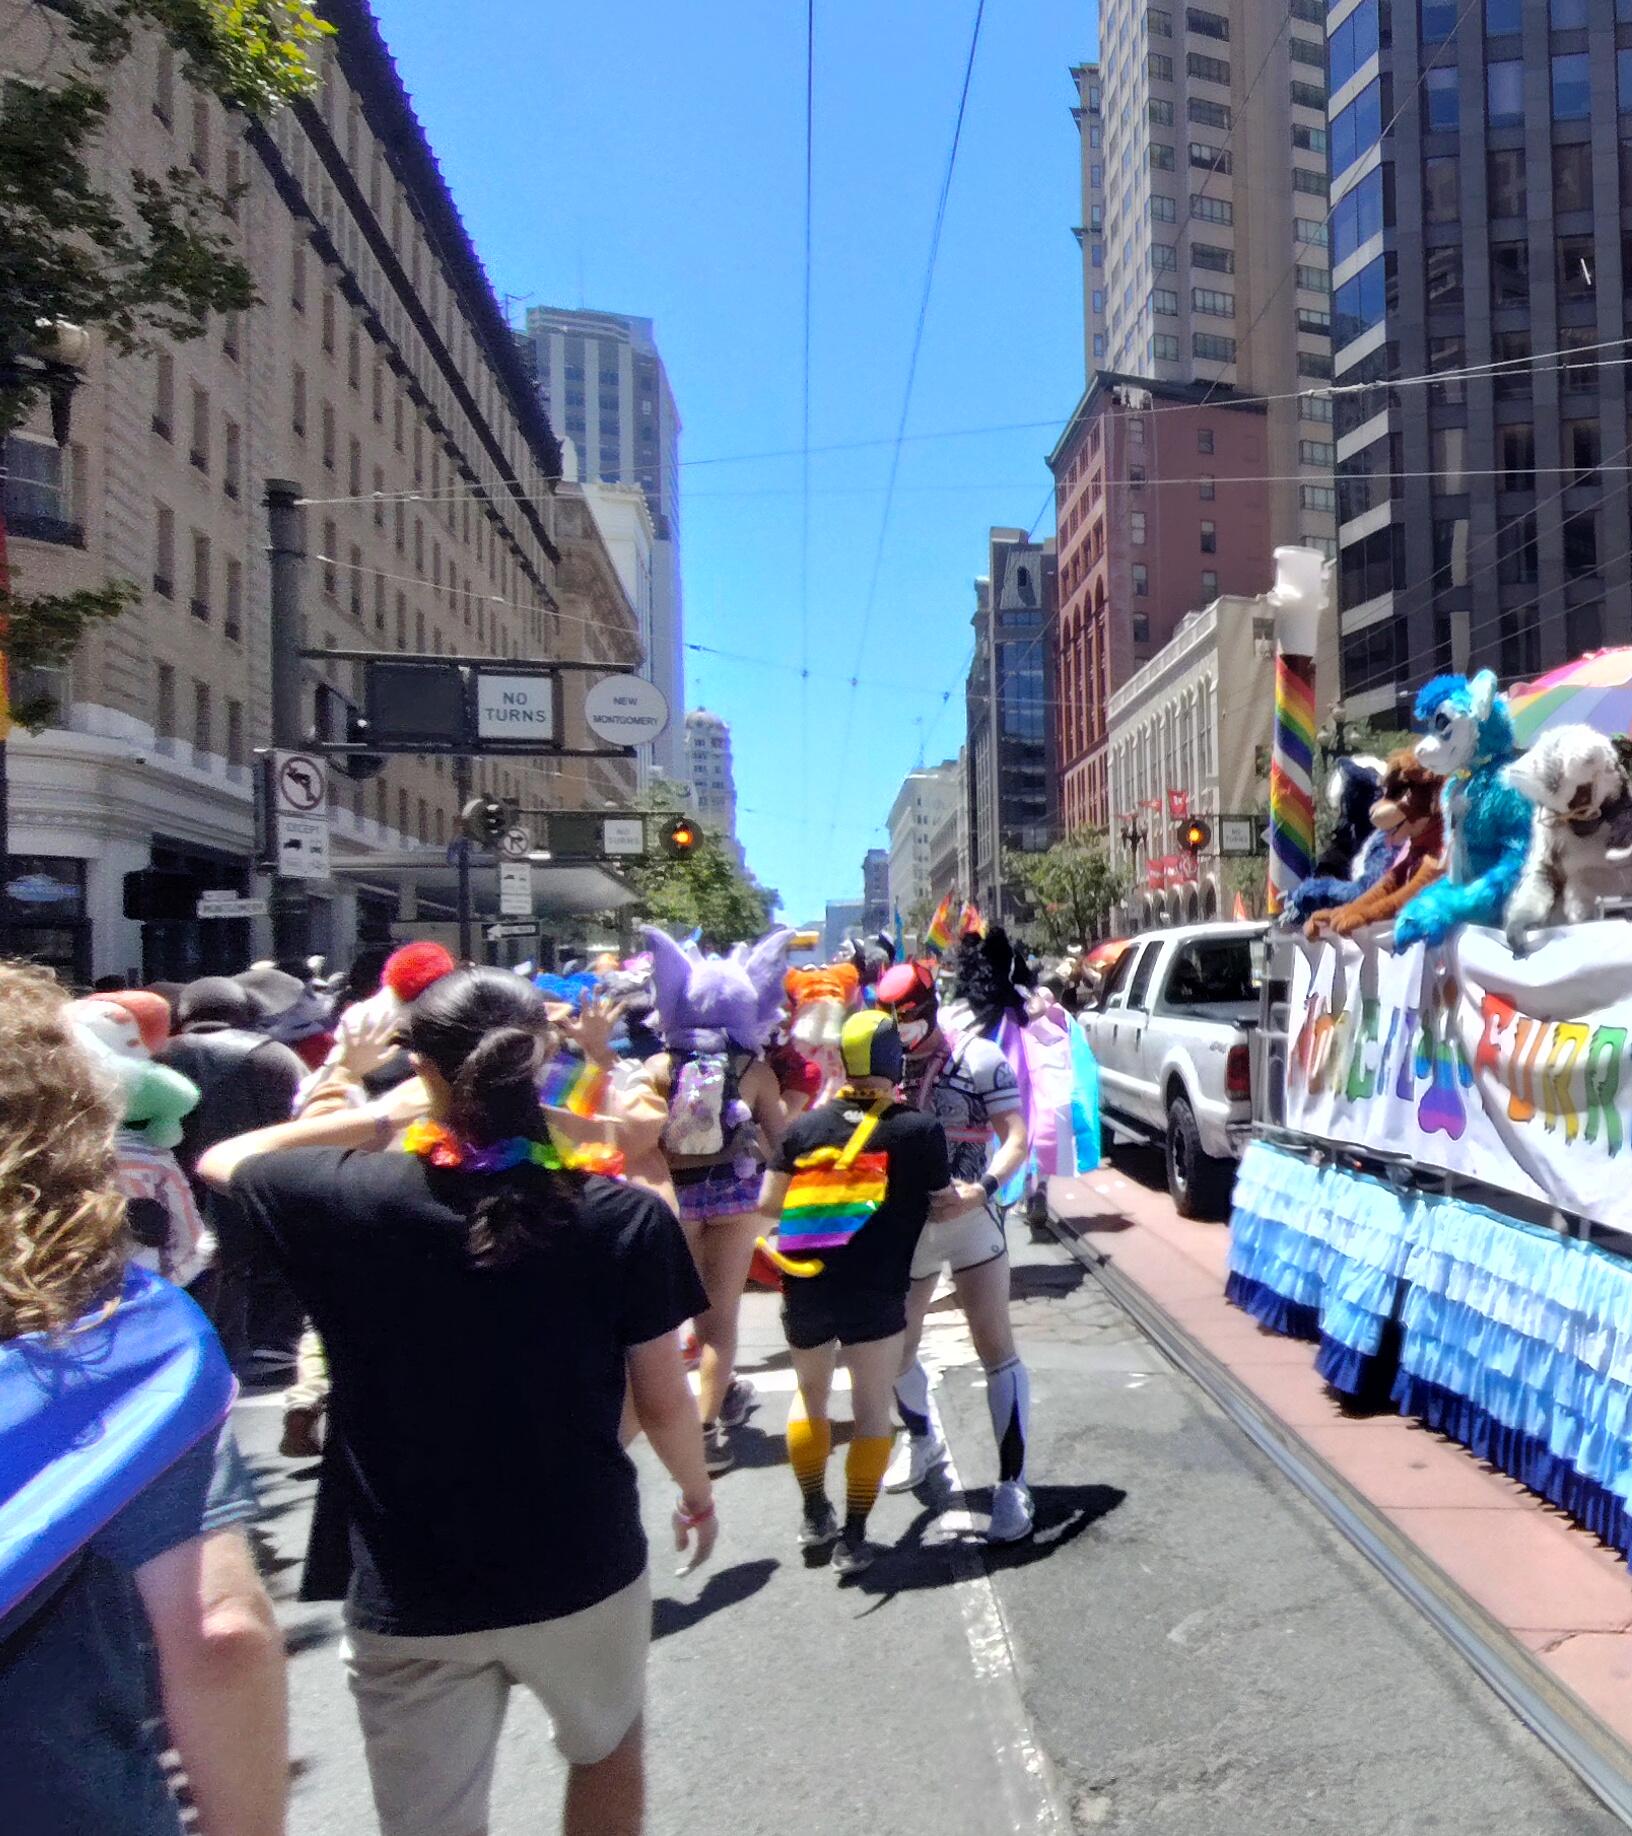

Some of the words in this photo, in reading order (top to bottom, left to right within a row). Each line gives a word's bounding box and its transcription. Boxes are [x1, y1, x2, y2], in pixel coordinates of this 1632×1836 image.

[502, 691, 528, 706] NO
[612, 696, 638, 707] NEW
[484, 708, 547, 723] TURNS
[592, 713, 658, 727] MONTGOMERY
